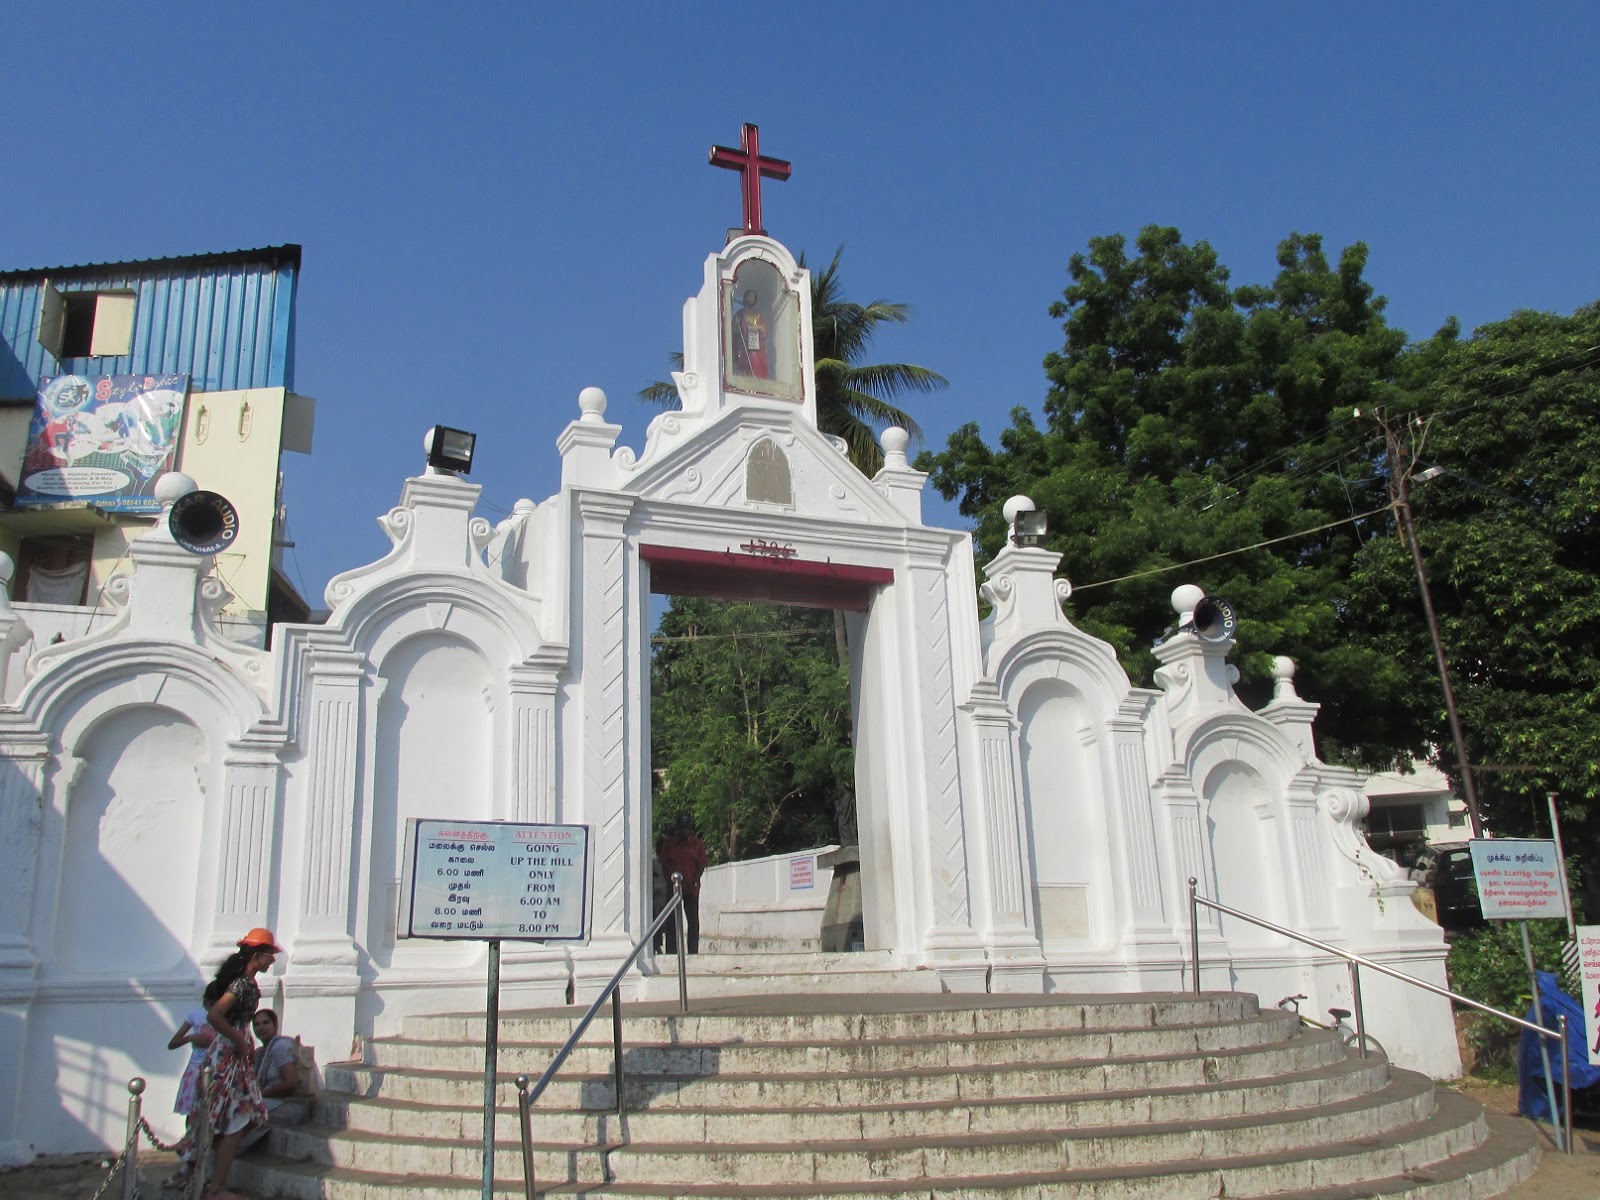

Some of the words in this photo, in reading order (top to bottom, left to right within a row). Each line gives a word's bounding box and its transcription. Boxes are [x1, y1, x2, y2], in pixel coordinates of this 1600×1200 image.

[143, 375, 178, 391] Dance
[210, 500, 235, 540] AUDIO
[515, 831, 572, 840] ATTENTION
[469, 843, 495, 851] செல்ல
[526, 844, 560, 853] GOING
[510, 857, 524, 866] UP
[527, 857, 547, 866] THE
[551, 858, 574, 866] HILL
[437, 868, 459, 876] 6.00
[464, 868, 484, 877] மணி
[529, 871, 555, 879] ONLY
[448, 881, 471, 891] முதல்
[527, 884, 555, 892] FROM
[448, 893, 470, 904] இரவு
[520, 897, 543, 906] 6.00
[545, 897, 560, 906] AM
[434, 907, 457, 915] 8.00
[461, 907, 482, 916] மணி
[533, 910, 547, 919] TO
[457, 920, 484, 931] மட்டும்
[518, 924, 542, 932] 8.00
[545, 924, 560, 932] PM
